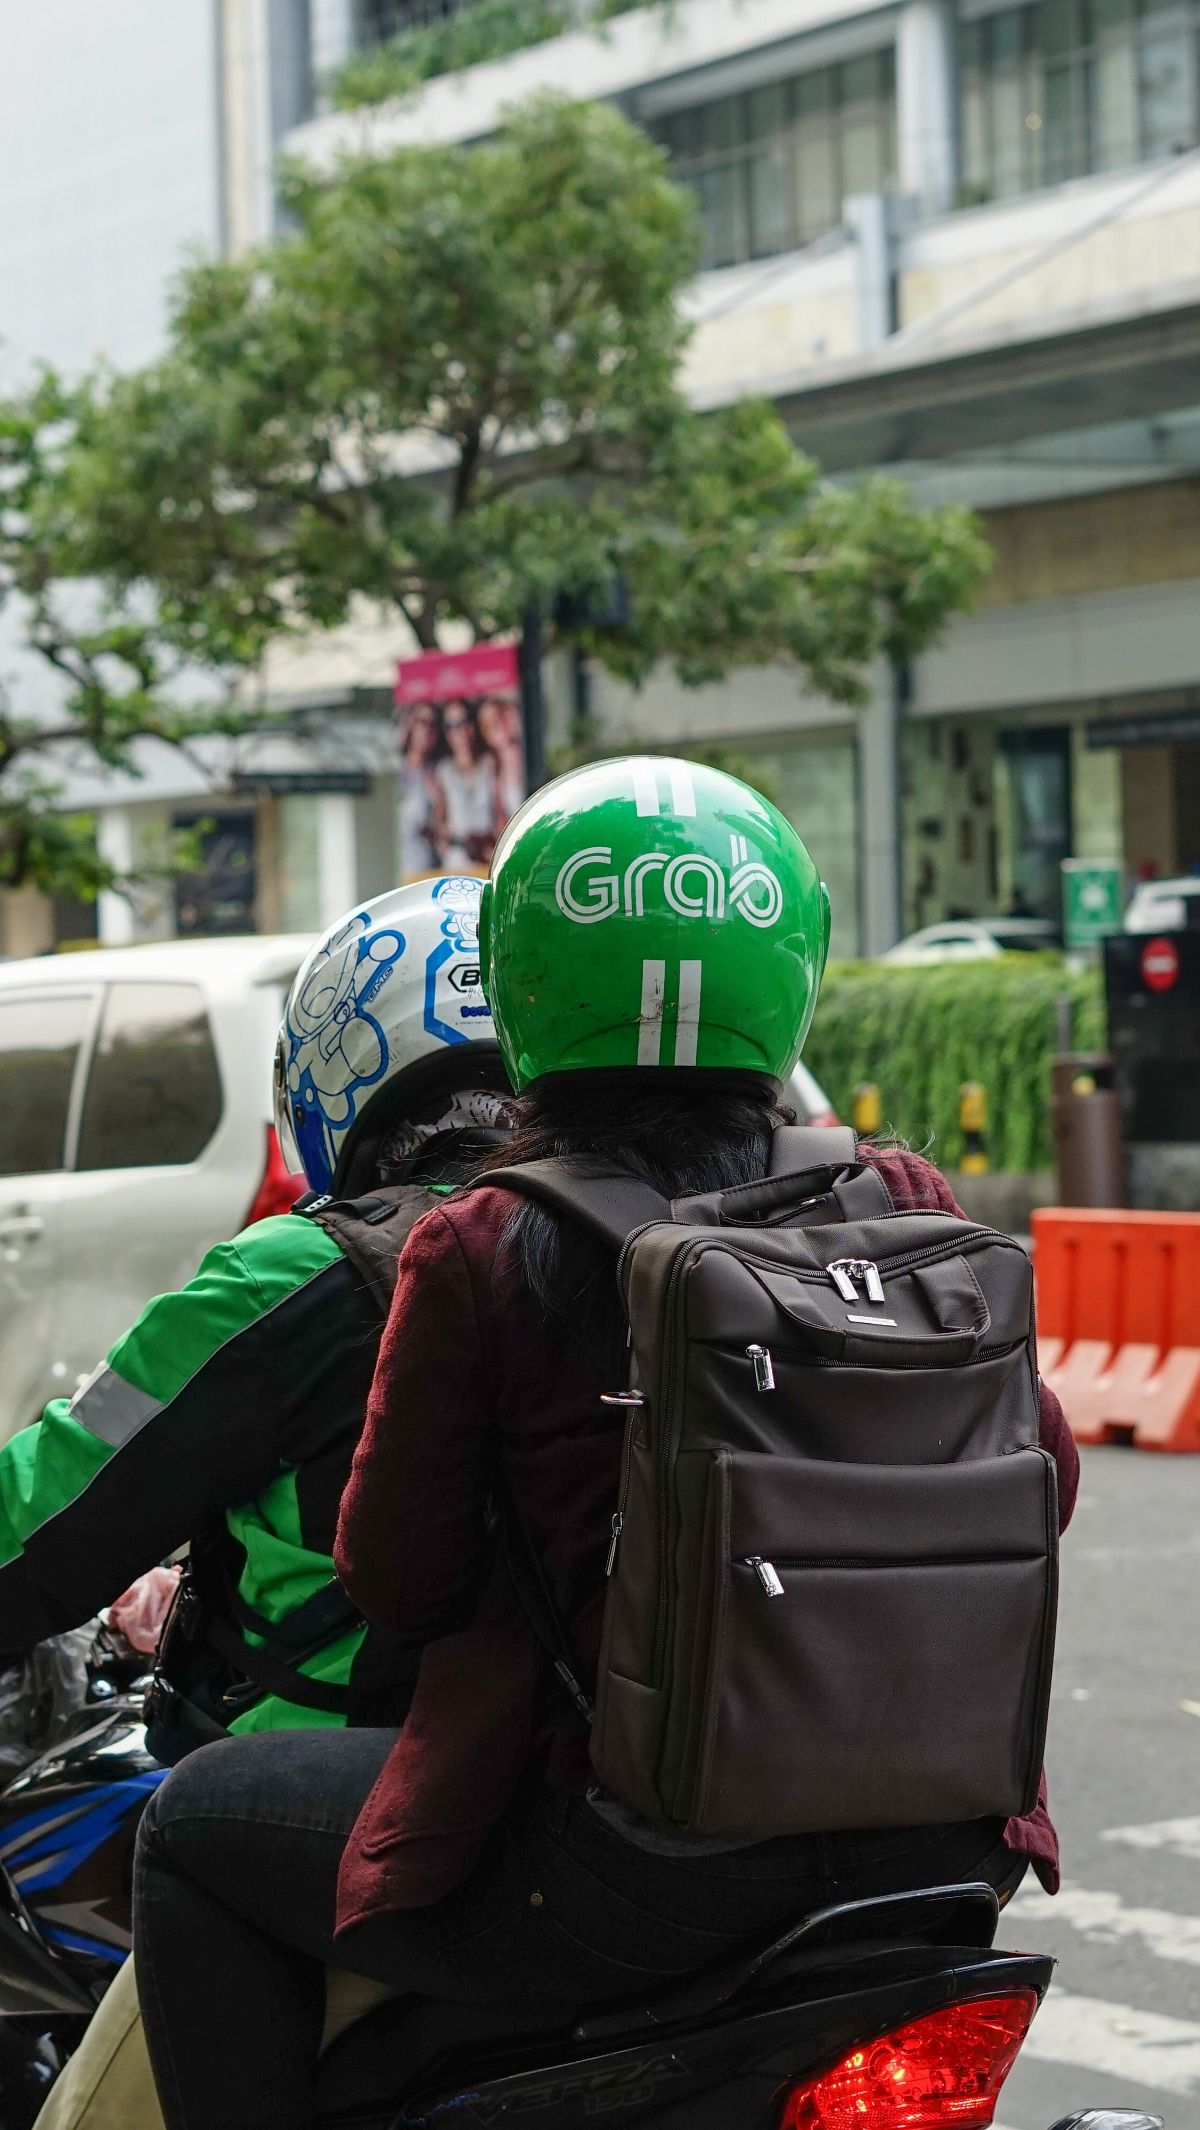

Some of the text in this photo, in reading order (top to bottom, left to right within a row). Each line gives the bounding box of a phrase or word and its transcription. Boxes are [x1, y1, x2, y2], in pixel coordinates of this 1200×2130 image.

[555, 834, 783, 928] Grab
[366, 965, 393, 1002] BMC
[460, 969, 481, 987] B
[460, 1005, 492, 1018] Dora
